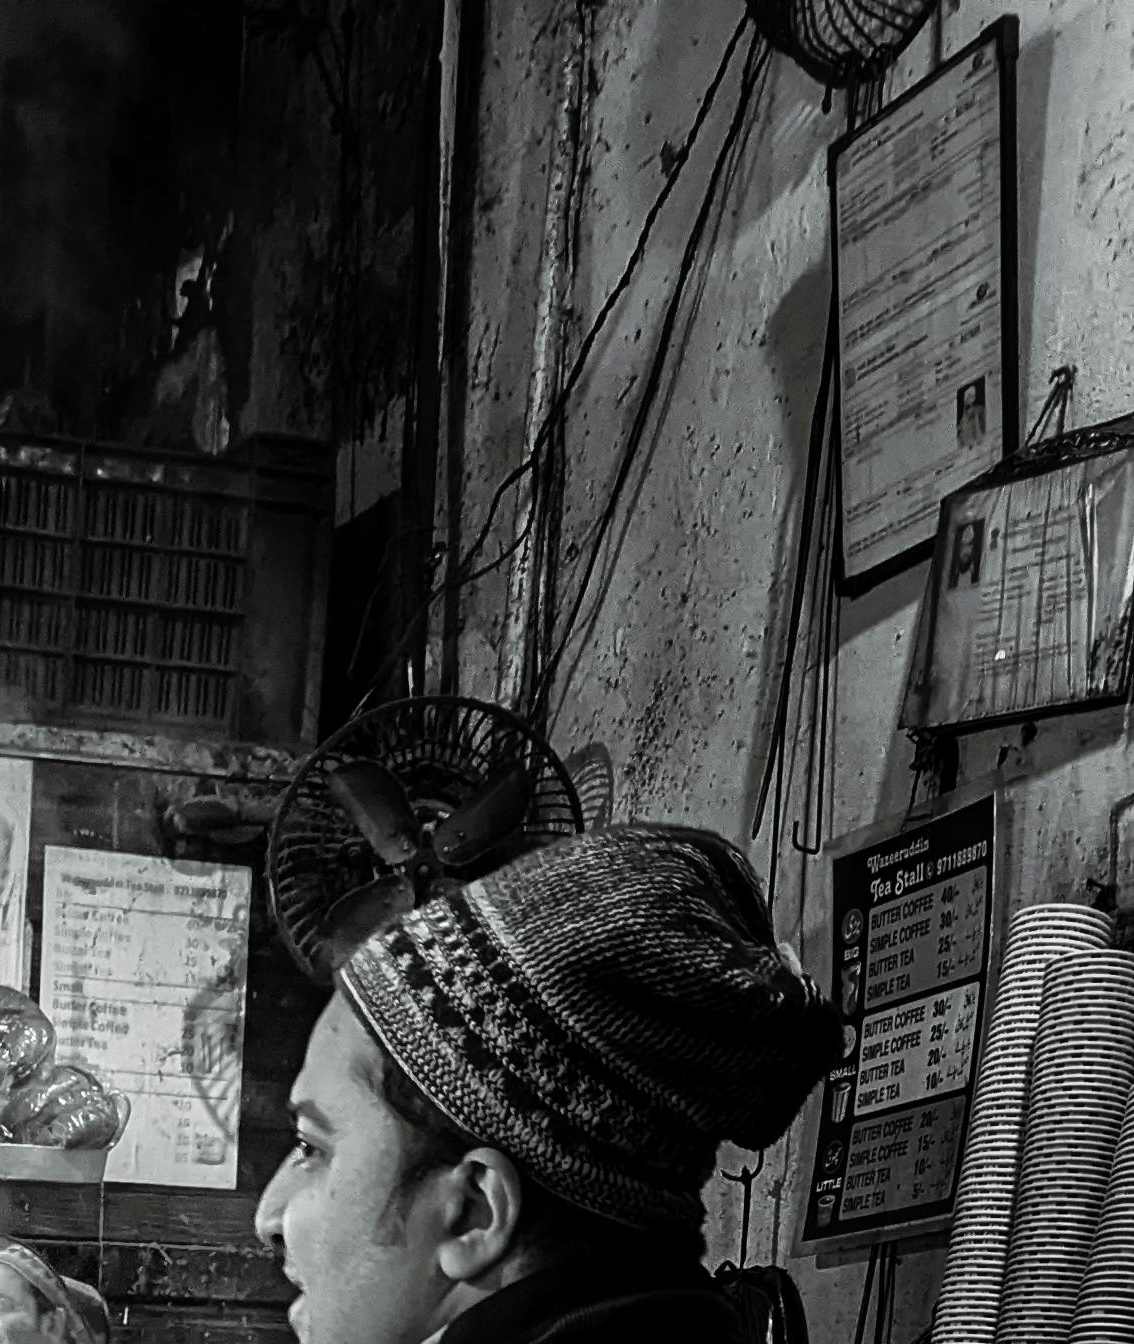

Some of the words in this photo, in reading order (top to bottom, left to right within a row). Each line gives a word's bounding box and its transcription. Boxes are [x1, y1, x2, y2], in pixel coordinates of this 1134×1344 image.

[870, 877, 892, 902] Tea
[895, 862, 925, 895] Stall
[871, 902, 901, 931] BUTTER
[902, 892, 934, 920] COFFEE
[940, 884, 960, 905] 40/-
[870, 930, 898, 954] SIMPLE
[899, 918, 931, 944] COFFEE
[939, 908, 958, 930] 30/-
[844, 946, 859, 961] BIG
[868, 954, 898, 978] BUTTER
[900, 948, 915, 967] TEA
[937, 933, 957, 955] 25/-
[867, 979, 895, 1002] SIMPLE
[896, 973, 911, 992] TEA
[937, 958, 955, 979] 15/-
[864, 1015, 893, 1039] BUTTER
[894, 1005, 926, 1029] COFFEE
[933, 996, 951, 1018] 30/-
[862, 1039, 890, 1062] SIMPLE
[890, 1030, 922, 1053] COFFEE
[930, 1022, 949, 1043] 25/-
[829, 1065, 856, 1081] SMALL
[857, 1086, 885, 1108] SIMPLE
[886, 1082, 900, 1101] TEA
[925, 1070, 943, 1091] 10/-
[860, 1063, 889, 1086] BUTTER
[891, 1058, 905, 1077] TEA
[852, 1123, 882, 1146] BUTTER
[882, 1115, 915, 1138] COFFEE
[849, 1146, 877, 1168] SIMPLE
[877, 1139, 909, 1162] COFFEE
[816, 1176, 842, 1192] LITTLE
[846, 1170, 875, 1191] BUTTER
[876, 1167, 891, 1185] TEA
[842, 1192, 871, 1214] SIMPLE
[872, 1190, 886, 1206] TEA
